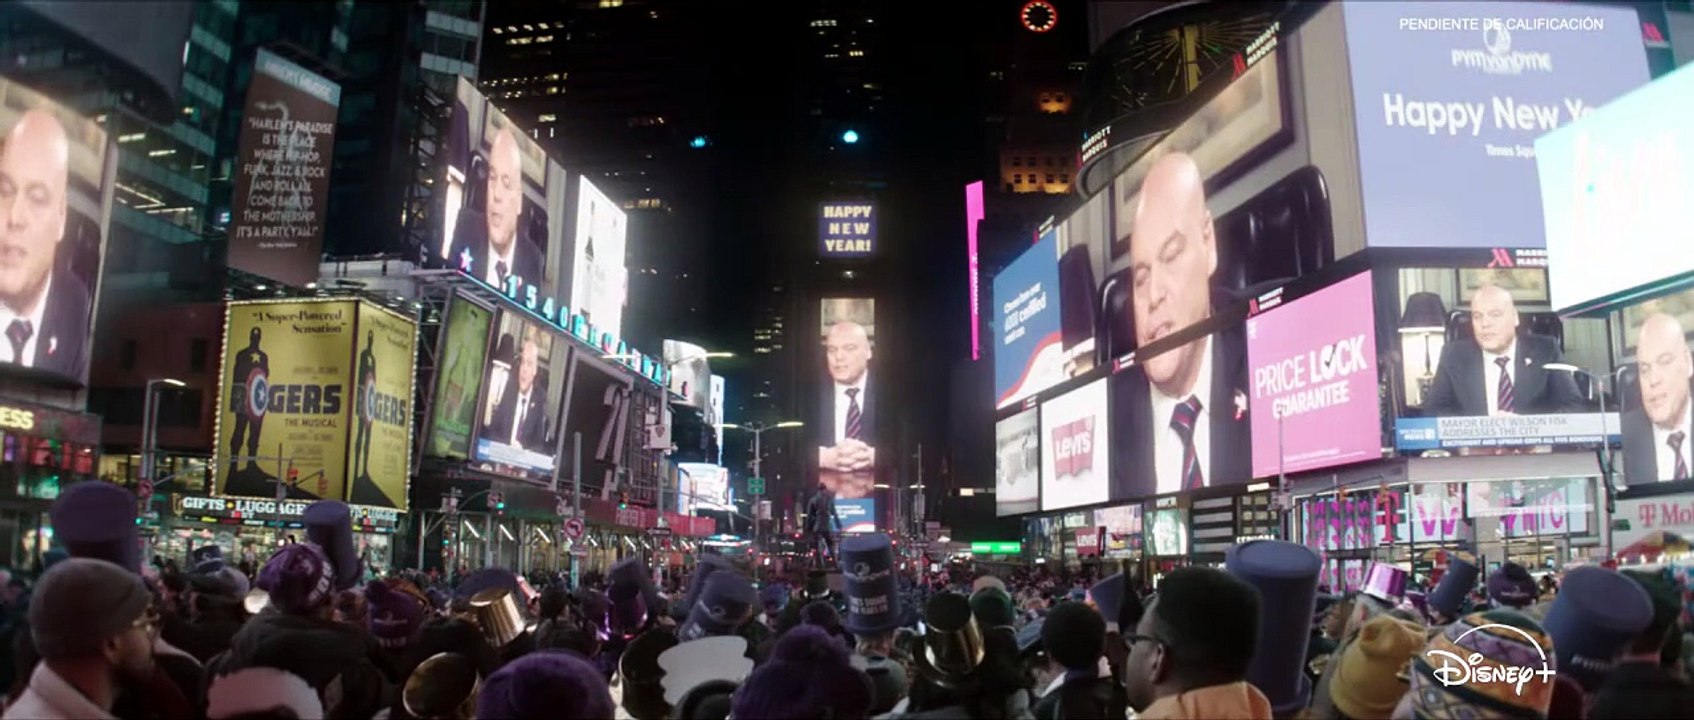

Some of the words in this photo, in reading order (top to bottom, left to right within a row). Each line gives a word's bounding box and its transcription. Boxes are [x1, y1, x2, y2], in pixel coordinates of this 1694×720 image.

[1383, 93, 1484, 136] Happy
[1492, 95, 1558, 131] New
[262, 133, 270, 145] IS
[1082, 125, 1111, 152] MARRIOTT
[1485, 143, 1514, 157] Times
[254, 180, 273, 191] AND
[250, 195, 277, 207] COME
[244, 210, 260, 221] THE
[823, 205, 872, 218] HAPPY
[236, 226, 253, 238] IT'S
[254, 226, 260, 237] A
[829, 222, 870, 235] NEW
[825, 239, 872, 252] YEAR!
[265, 309, 342, 326] Super-Powered
[291, 321, 347, 334] Sensation"
[1255, 354, 1307, 399] PRICE
[1309, 333, 1368, 384] LOCK
[1272, 379, 1351, 420] GUARANTEE
[284, 418, 300, 427] THE
[301, 418, 338, 428] MUSICAL
[1441, 419, 1477, 428] MAYOR
[1479, 418, 1507, 427] ELECT
[1509, 417, 1547, 427] WILSON
[1549, 416, 1568, 425] FISK
[1441, 427, 1497, 437] ADDRESSES
[1499, 426, 1518, 436] THE
[1519, 426, 1540, 436] CITY
[183, 497, 226, 511] GIFTS
[235, 501, 306, 516] LUGGAGE
